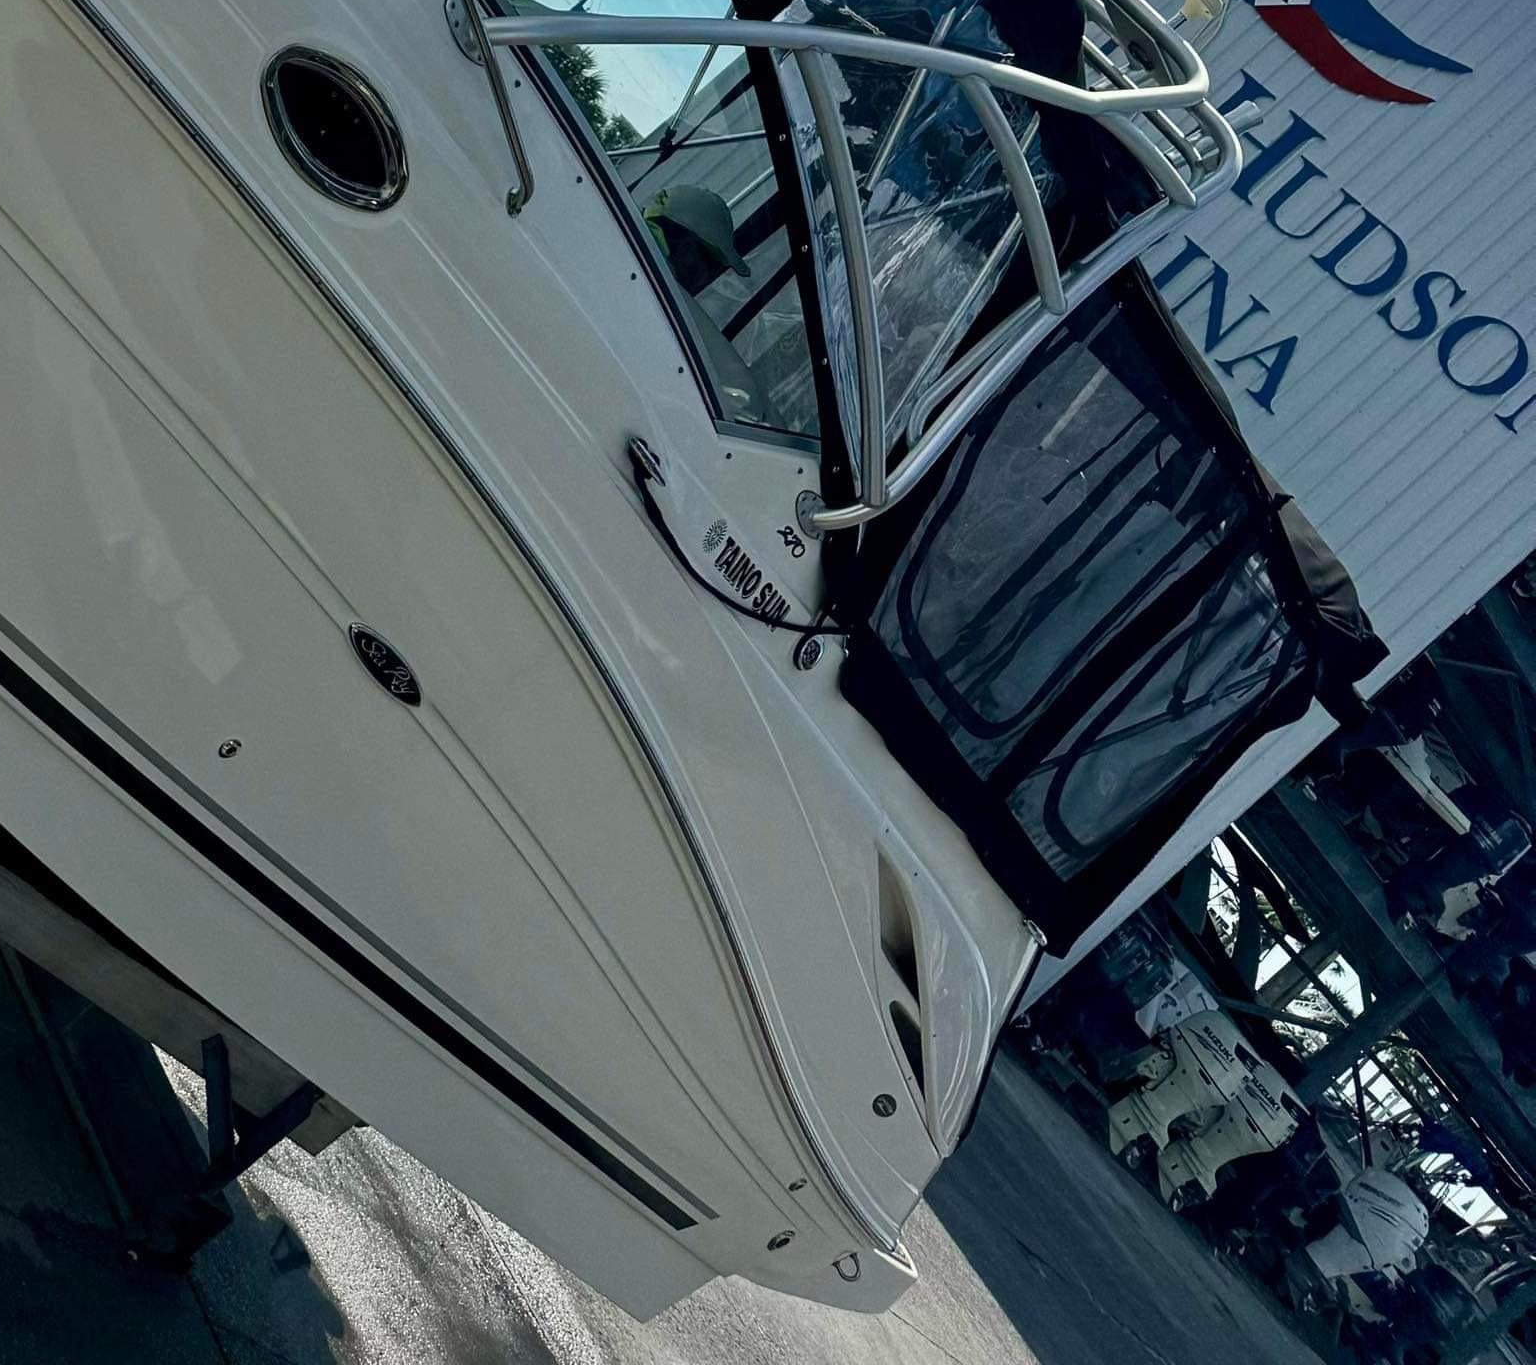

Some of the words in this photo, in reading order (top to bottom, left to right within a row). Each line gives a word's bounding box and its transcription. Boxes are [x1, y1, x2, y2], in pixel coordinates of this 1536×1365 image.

[776, 525, 806, 558] 270
[714, 536, 762, 599] TAINO
[752, 582, 791, 632] SUN
[361, 639, 386, 667] Sea
[383, 666, 415, 693] Ray
[1203, 1026, 1235, 1063] SUZUKI
[1251, 1076, 1281, 1111] UZUKI
